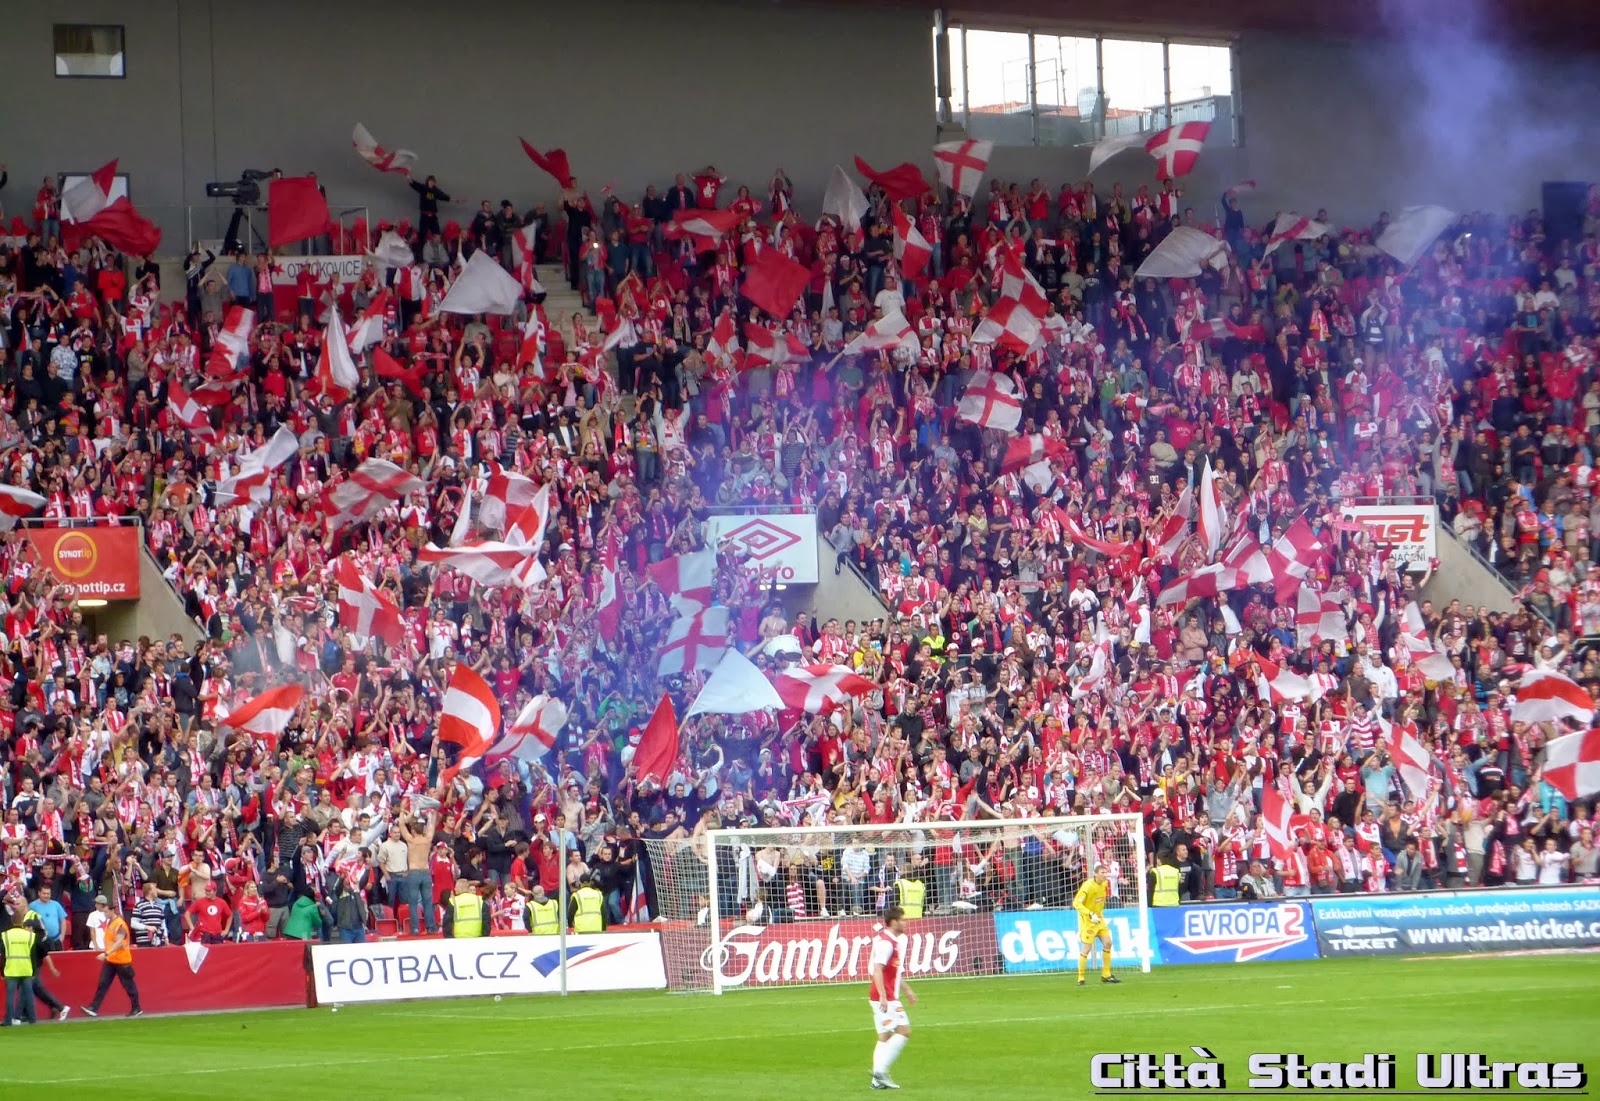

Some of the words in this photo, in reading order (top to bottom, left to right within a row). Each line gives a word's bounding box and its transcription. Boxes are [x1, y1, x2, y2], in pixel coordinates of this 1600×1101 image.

[287, 260, 360, 278] OTOKOVICE
[742, 563, 795, 580] mbro
[1429, 906, 1442, 916] na
[1188, 910, 1280, 936] EVROPA
[1328, 937, 1398, 951] TICKET
[326, 951, 521, 988] FOTBAL.CZ
